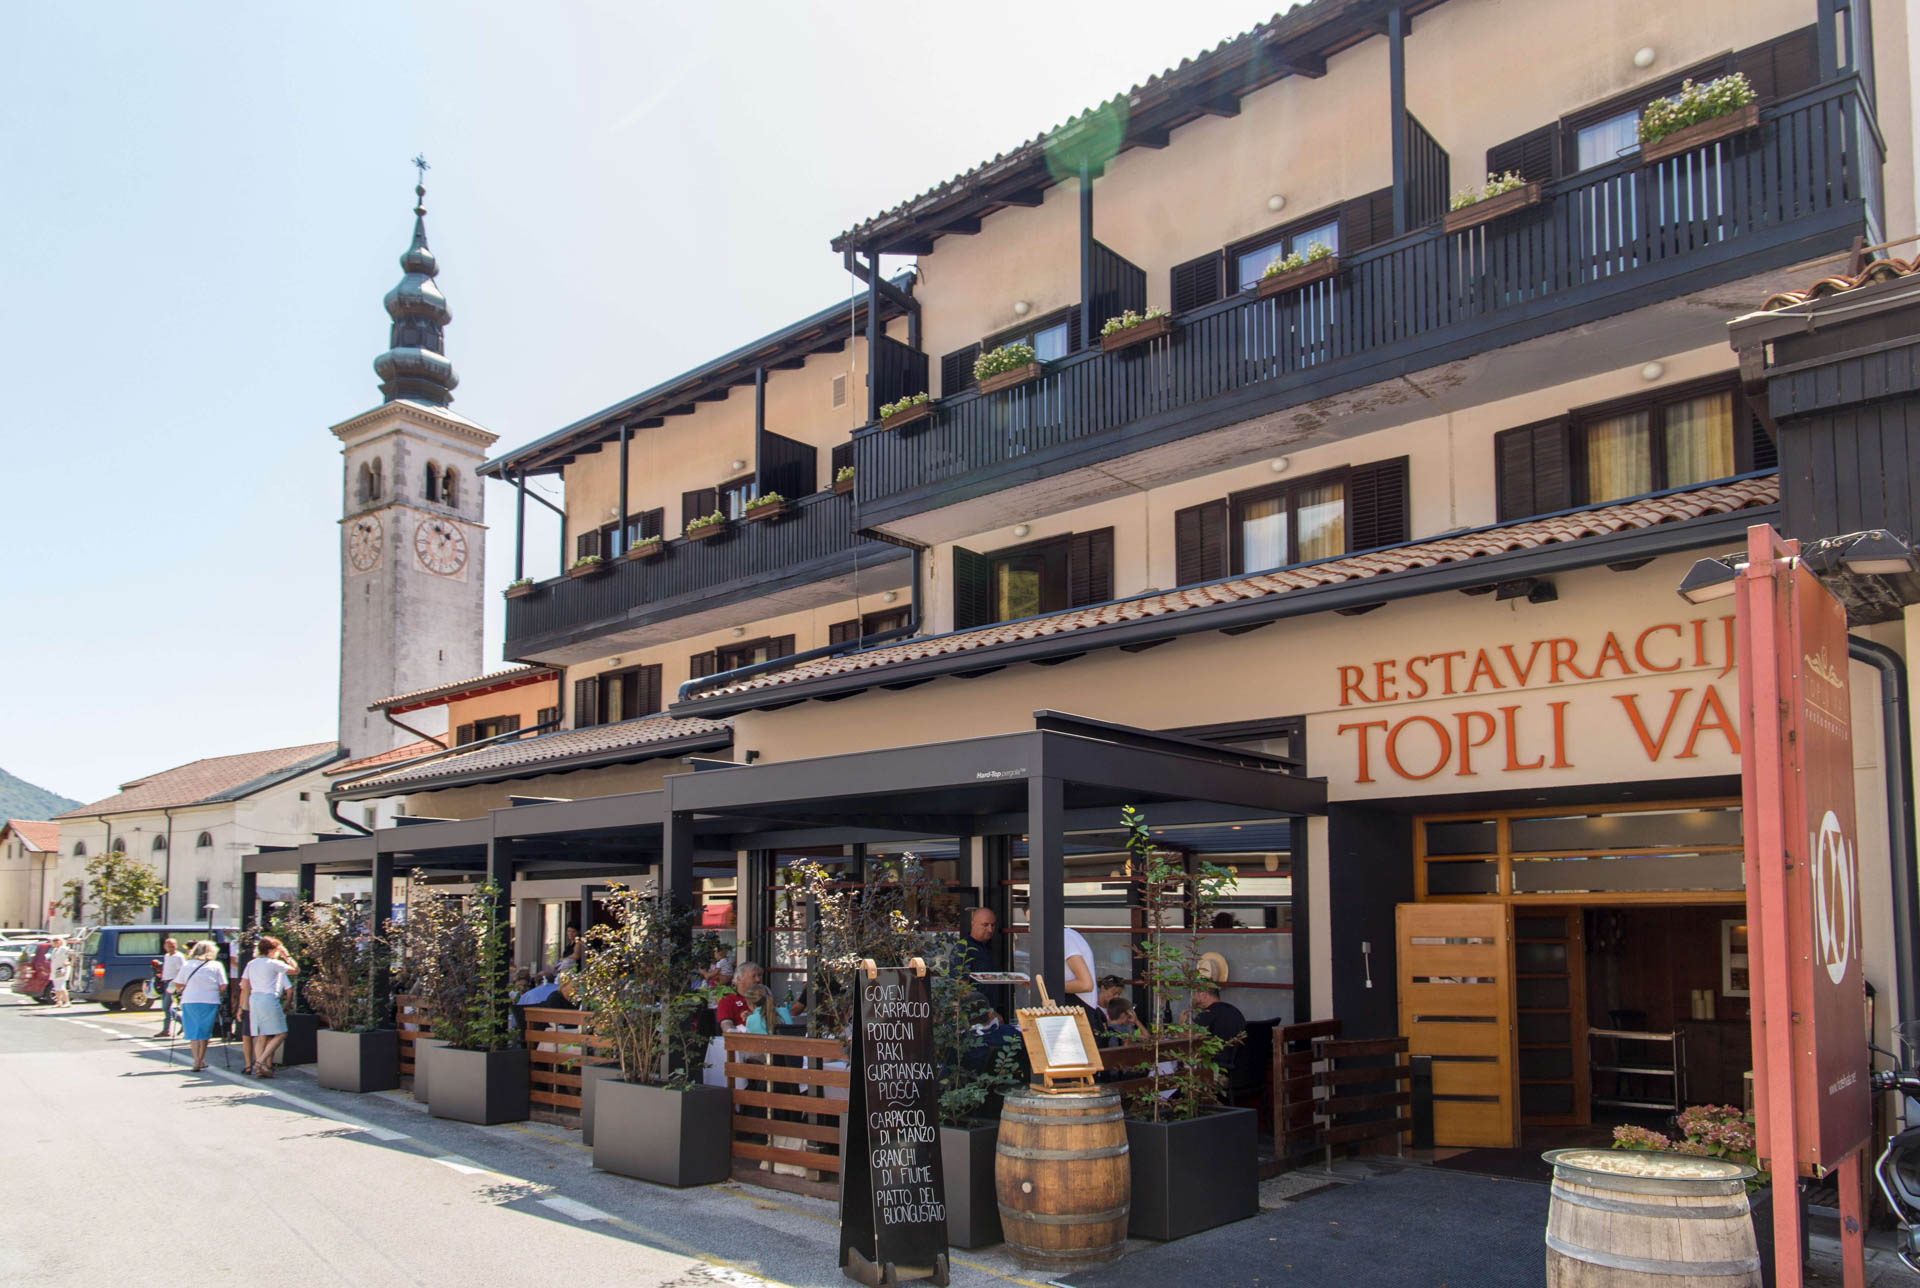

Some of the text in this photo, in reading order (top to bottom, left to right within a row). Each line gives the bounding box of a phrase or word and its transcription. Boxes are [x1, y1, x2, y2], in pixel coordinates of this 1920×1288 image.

[1336, 615, 1737, 706] RESTAVRACIJ
[1337, 684, 1742, 783] TOPLI VA
[865, 984, 905, 1001] GOVEJI
[874, 1001, 930, 1018] KARPACCIO
[867, 1020, 915, 1041] POTOČNI
[876, 1042, 904, 1061] RAKI
[867, 1062, 935, 1081] GURMANSKA
[879, 1079, 920, 1100] PLOŠČA
[870, 1109, 926, 1129] CARPACCIO
[880, 1126, 936, 1146] DI MANZO
[872, 1148, 917, 1168] GRANCHI
[882, 1165, 933, 1186] DI FIUME
[877, 1187, 940, 1207] PIATTO DEL
[883, 1204, 946, 1225] BUONGUSTAIO
